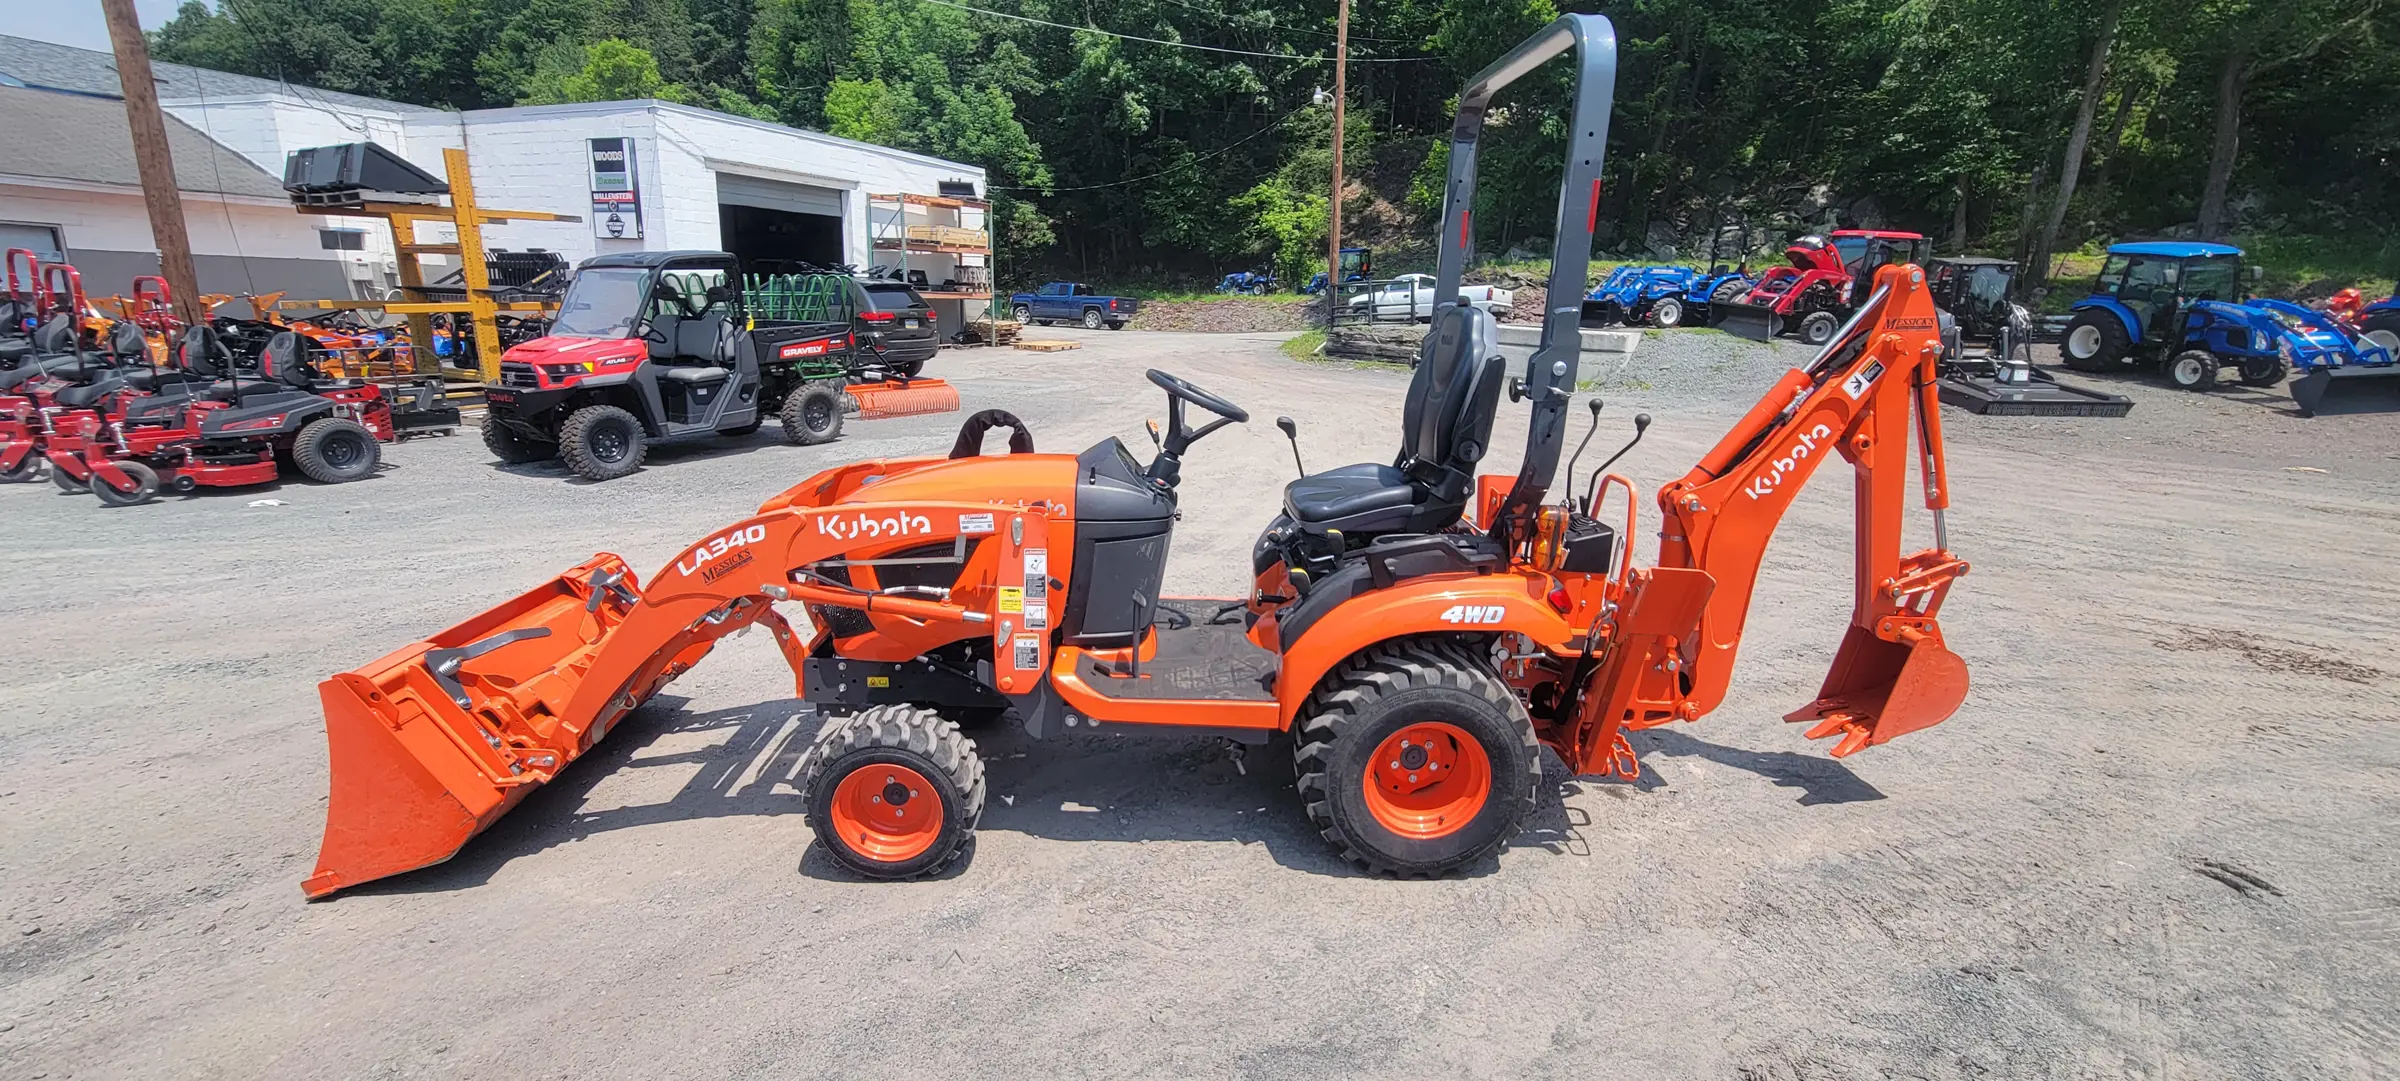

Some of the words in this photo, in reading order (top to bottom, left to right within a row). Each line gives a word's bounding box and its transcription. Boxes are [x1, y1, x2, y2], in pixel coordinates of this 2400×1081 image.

[593, 151, 623, 161] WOODS
[783, 345, 823, 357] GRAVELY
[1744, 423, 1832, 500] Kubota
[817, 510, 932, 540] Kubota
[676, 524, 766, 577] LA340
[1440, 605, 1506, 624] 4WD
